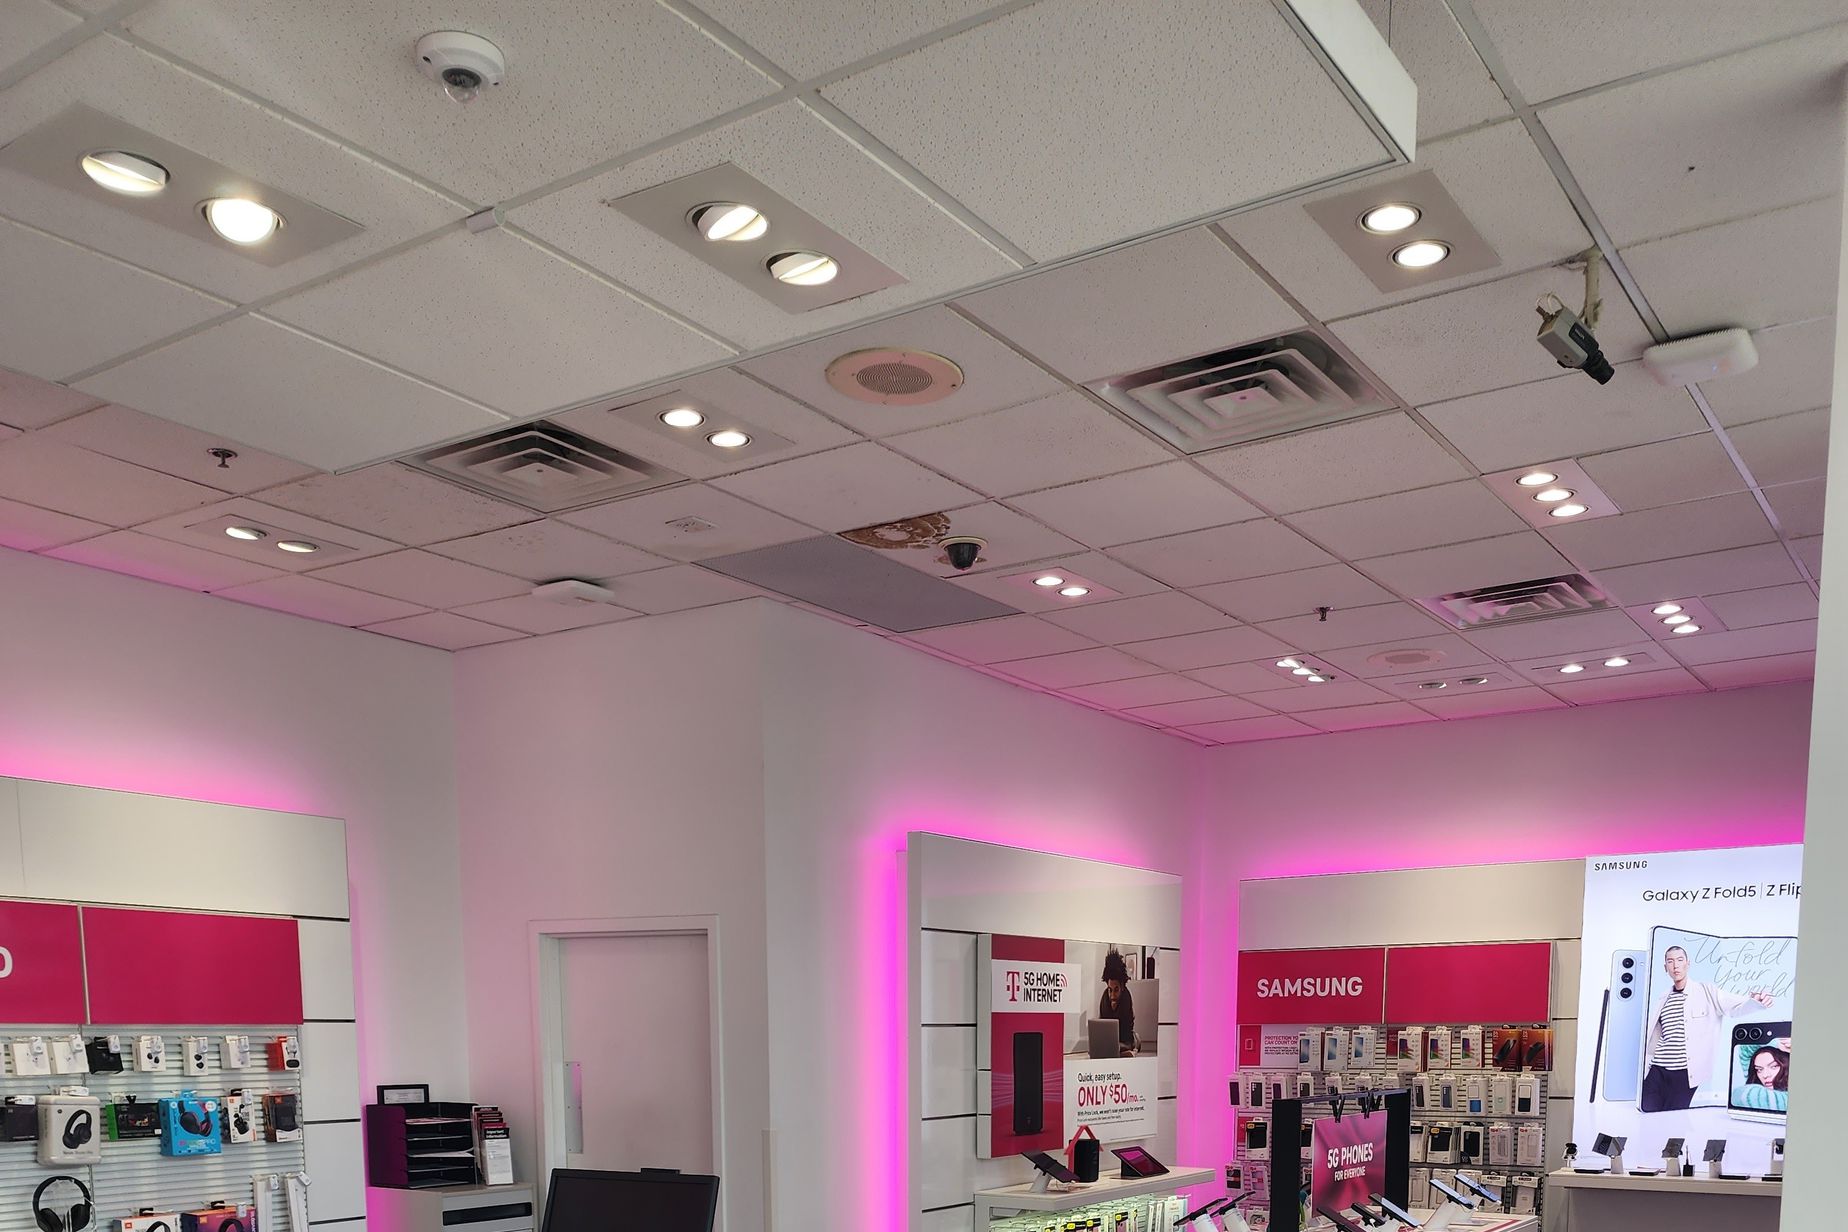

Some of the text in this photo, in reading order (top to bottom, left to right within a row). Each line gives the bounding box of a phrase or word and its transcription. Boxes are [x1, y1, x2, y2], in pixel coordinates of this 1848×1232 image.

[1594, 860, 1648, 871] SAMSUNG
[1642, 889, 1699, 903] Galaxy
[1702, 887, 1711, 899] Z
[1714, 885, 1757, 899] Fold5
[1766, 884, 1775, 896] Z
[1684, 936, 1791, 967] Unfold
[1024, 971, 1060, 987] 5G HOME
[1257, 976, 1363, 998] SAMSUNG
[1023, 987, 1063, 1003] INTERNET
[1077, 1072, 1095, 1083] Quick,
[1095, 1073, 1106, 1083] easy
[1078, 1085, 1108, 1107] ONLY
[1327, 1142, 1373, 1169] 5G PHONES
[1334, 1166, 1366, 1181] FOR EVERYONE
